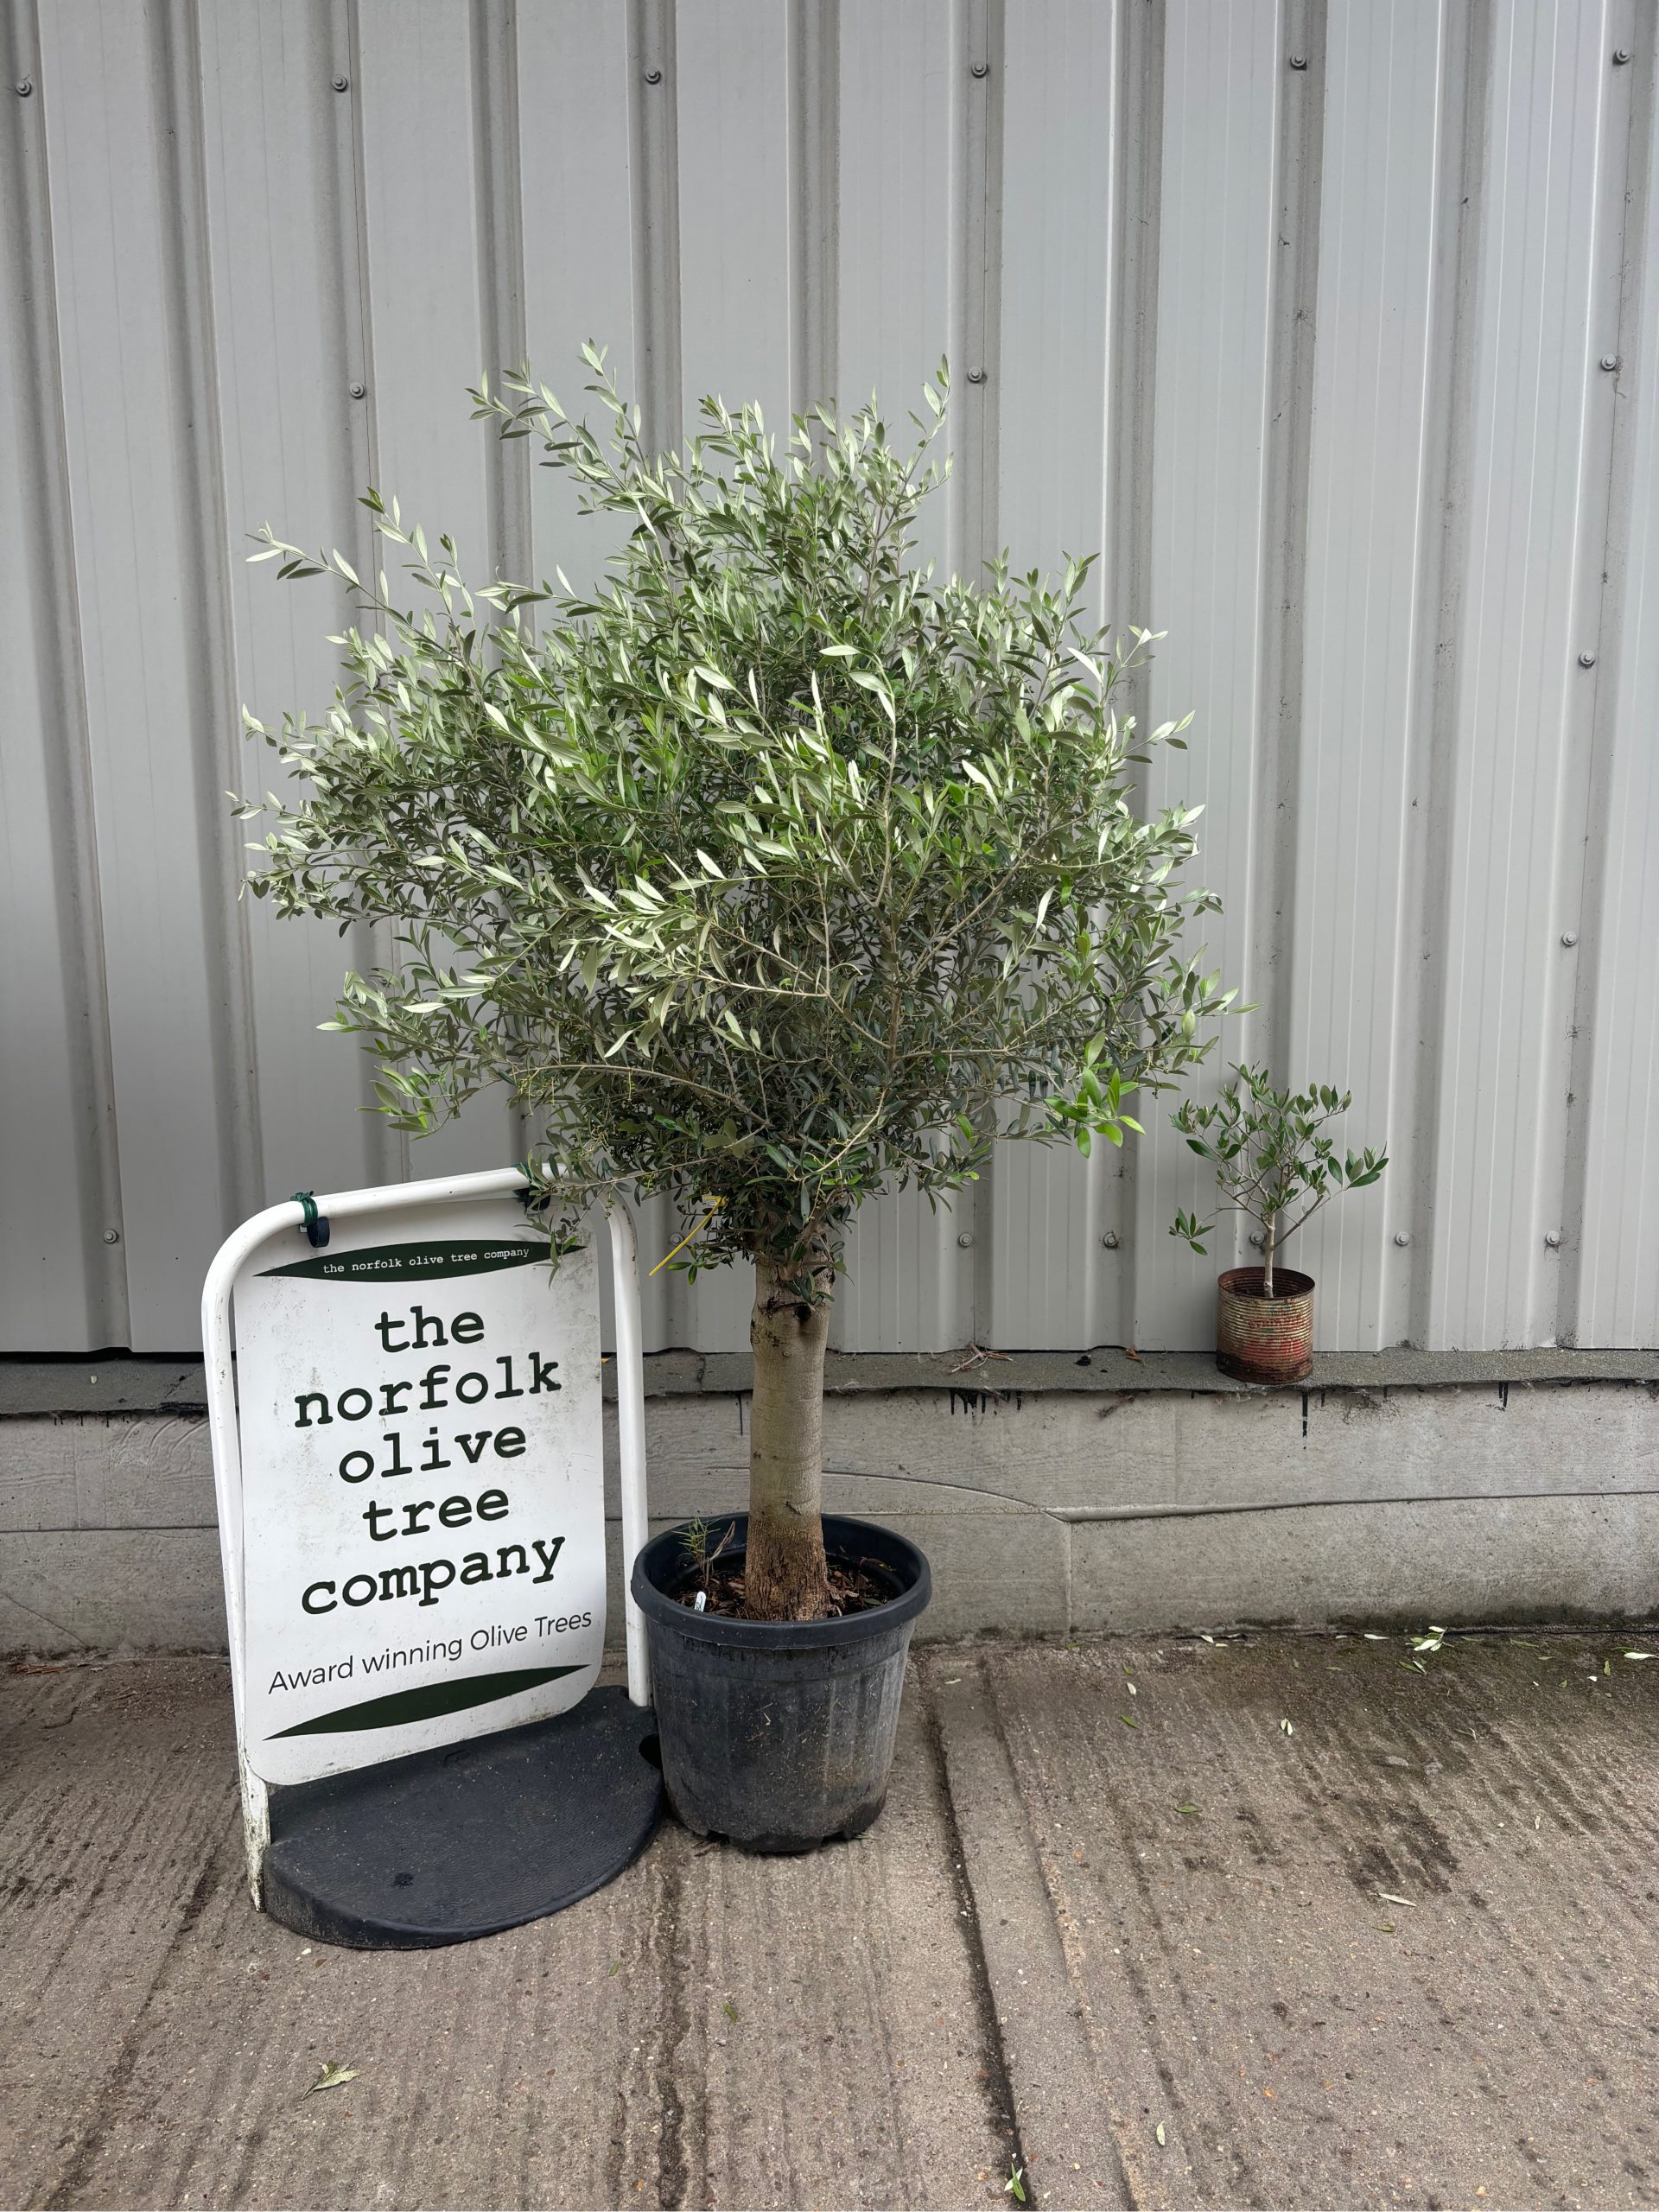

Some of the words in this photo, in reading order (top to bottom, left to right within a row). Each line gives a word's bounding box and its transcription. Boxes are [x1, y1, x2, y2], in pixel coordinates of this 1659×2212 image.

[322, 1263, 346, 1274] the
[352, 1257, 403, 1272] norfolk
[409, 1255, 444, 1267] olive
[450, 1251, 478, 1262] tree
[484, 1247, 531, 1260] company
[374, 1305, 485, 1353] the
[294, 1351, 563, 1428] norfolk
[339, 1426, 526, 1484] olive
[362, 1489, 509, 1541] tree
[301, 1535, 566, 1615] company
[268, 1655, 353, 1694] Award
[361, 1638, 462, 1674] winning
[470, 1625, 528, 1651] Olive
[534, 1611, 593, 1637] Trees
